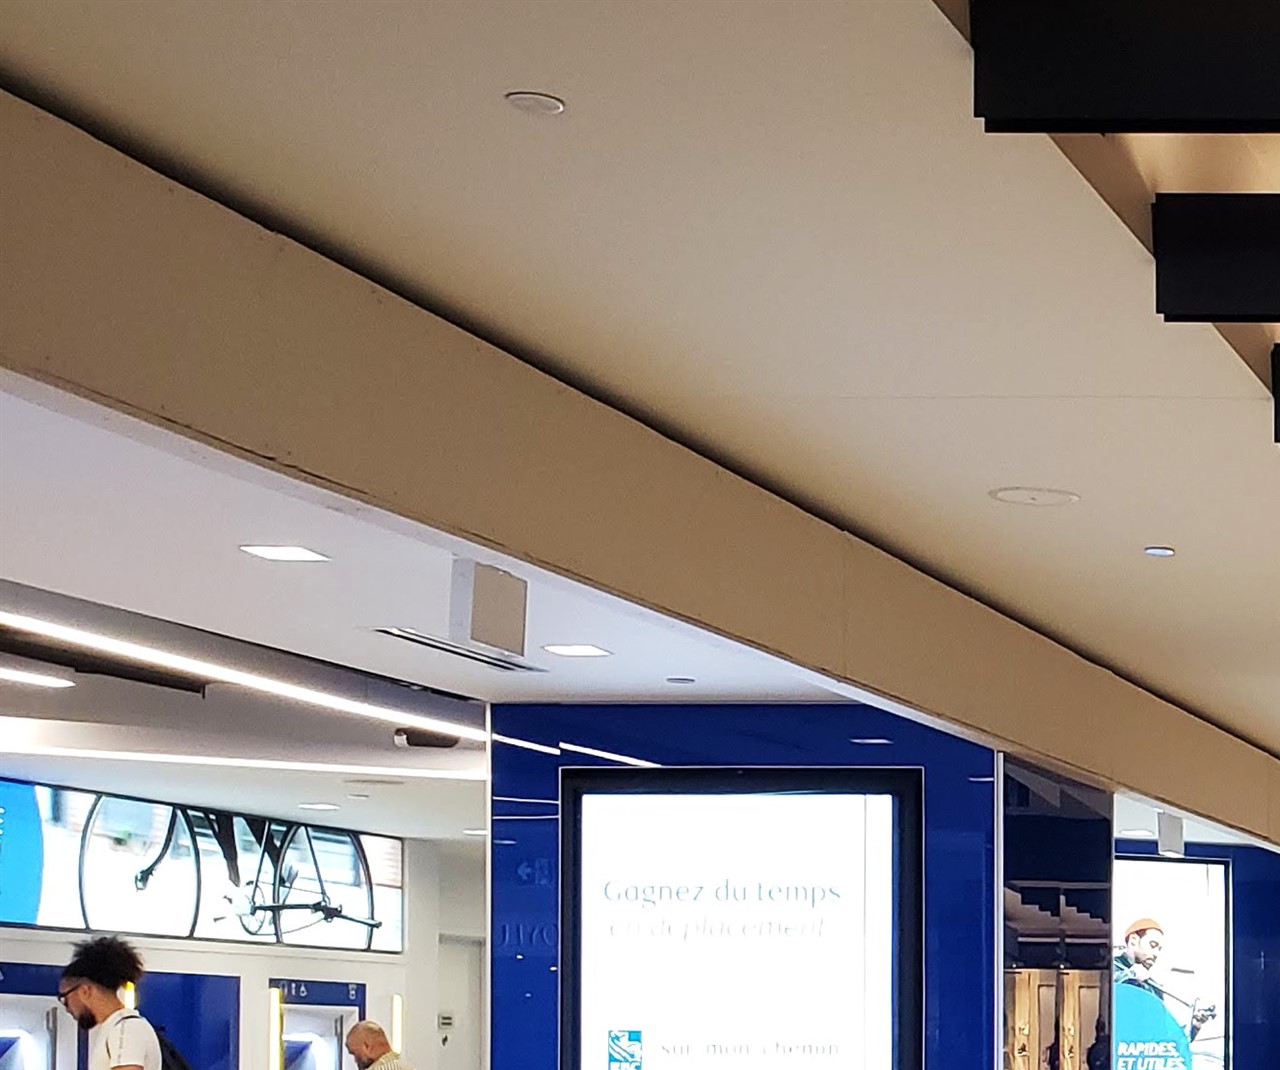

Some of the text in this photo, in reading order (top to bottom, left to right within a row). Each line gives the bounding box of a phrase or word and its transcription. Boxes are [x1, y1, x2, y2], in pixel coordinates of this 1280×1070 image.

[604, 878, 841, 908] Gagnez du temps
